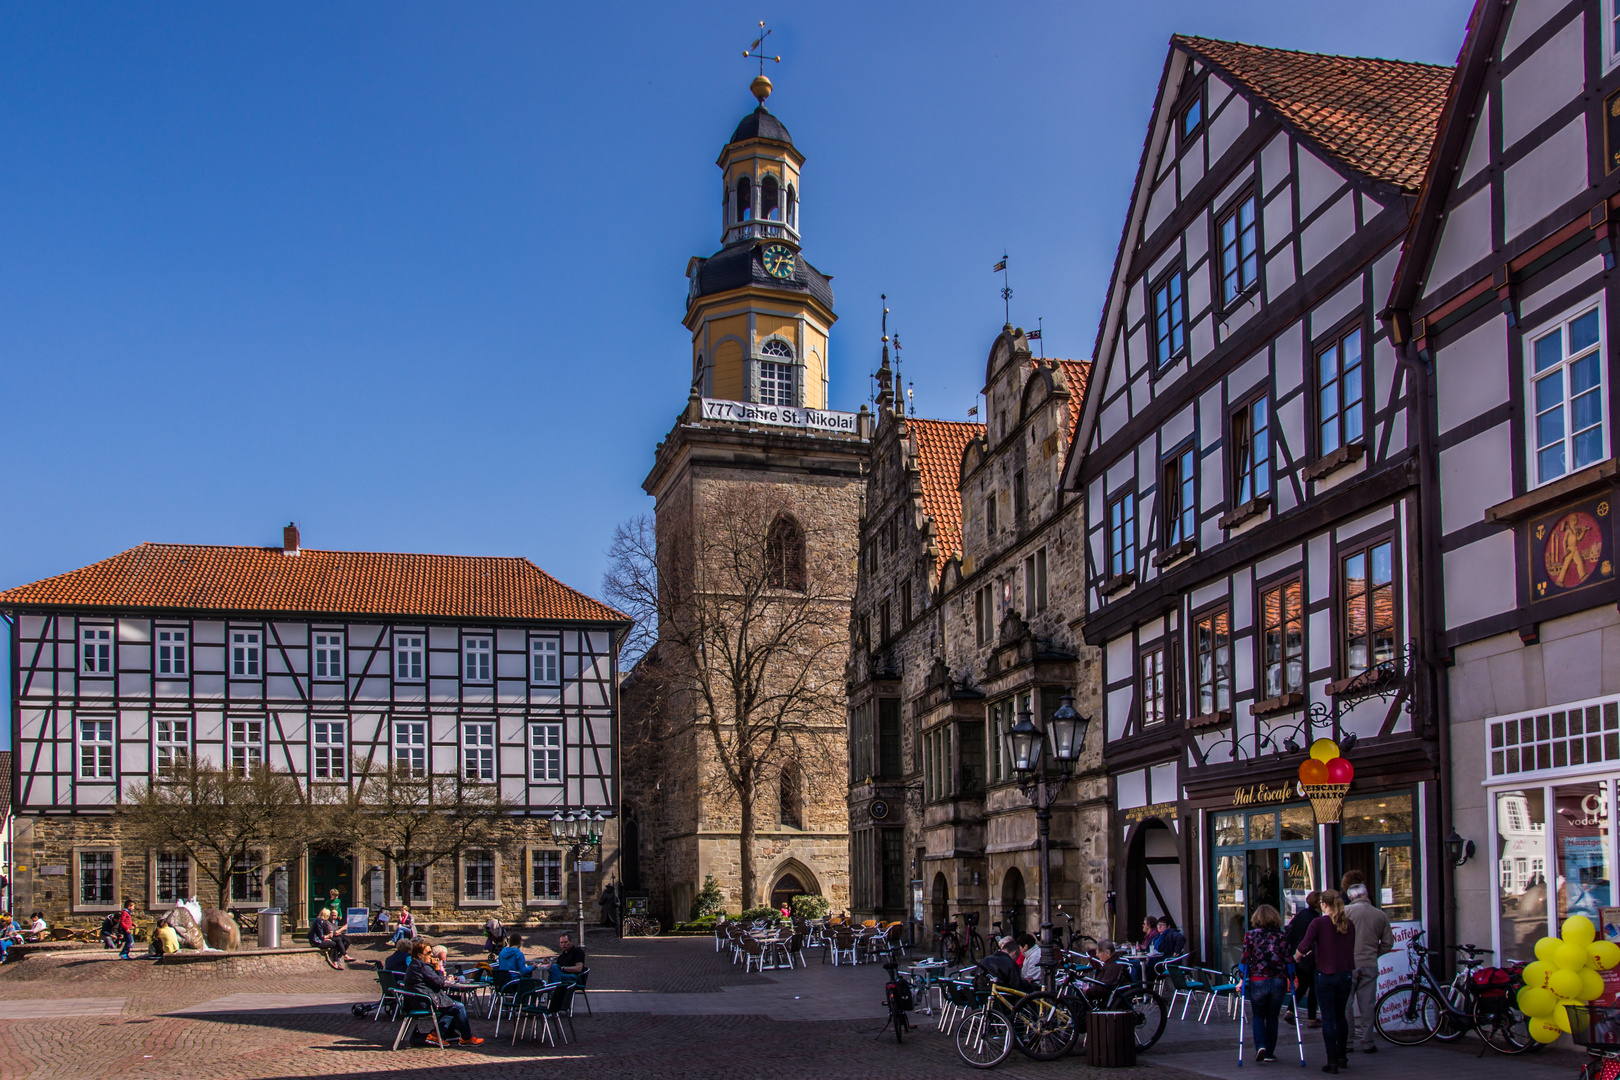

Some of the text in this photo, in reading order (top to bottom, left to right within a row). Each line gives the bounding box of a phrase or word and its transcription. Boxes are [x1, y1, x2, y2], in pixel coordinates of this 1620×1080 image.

[707, 402, 853, 429] 777 Jahre St. Nikolai
[1306, 784, 1346, 792] EISCAFE
[1233, 787, 1256, 805] Ital.
[1309, 792, 1345, 800] RIALTO
